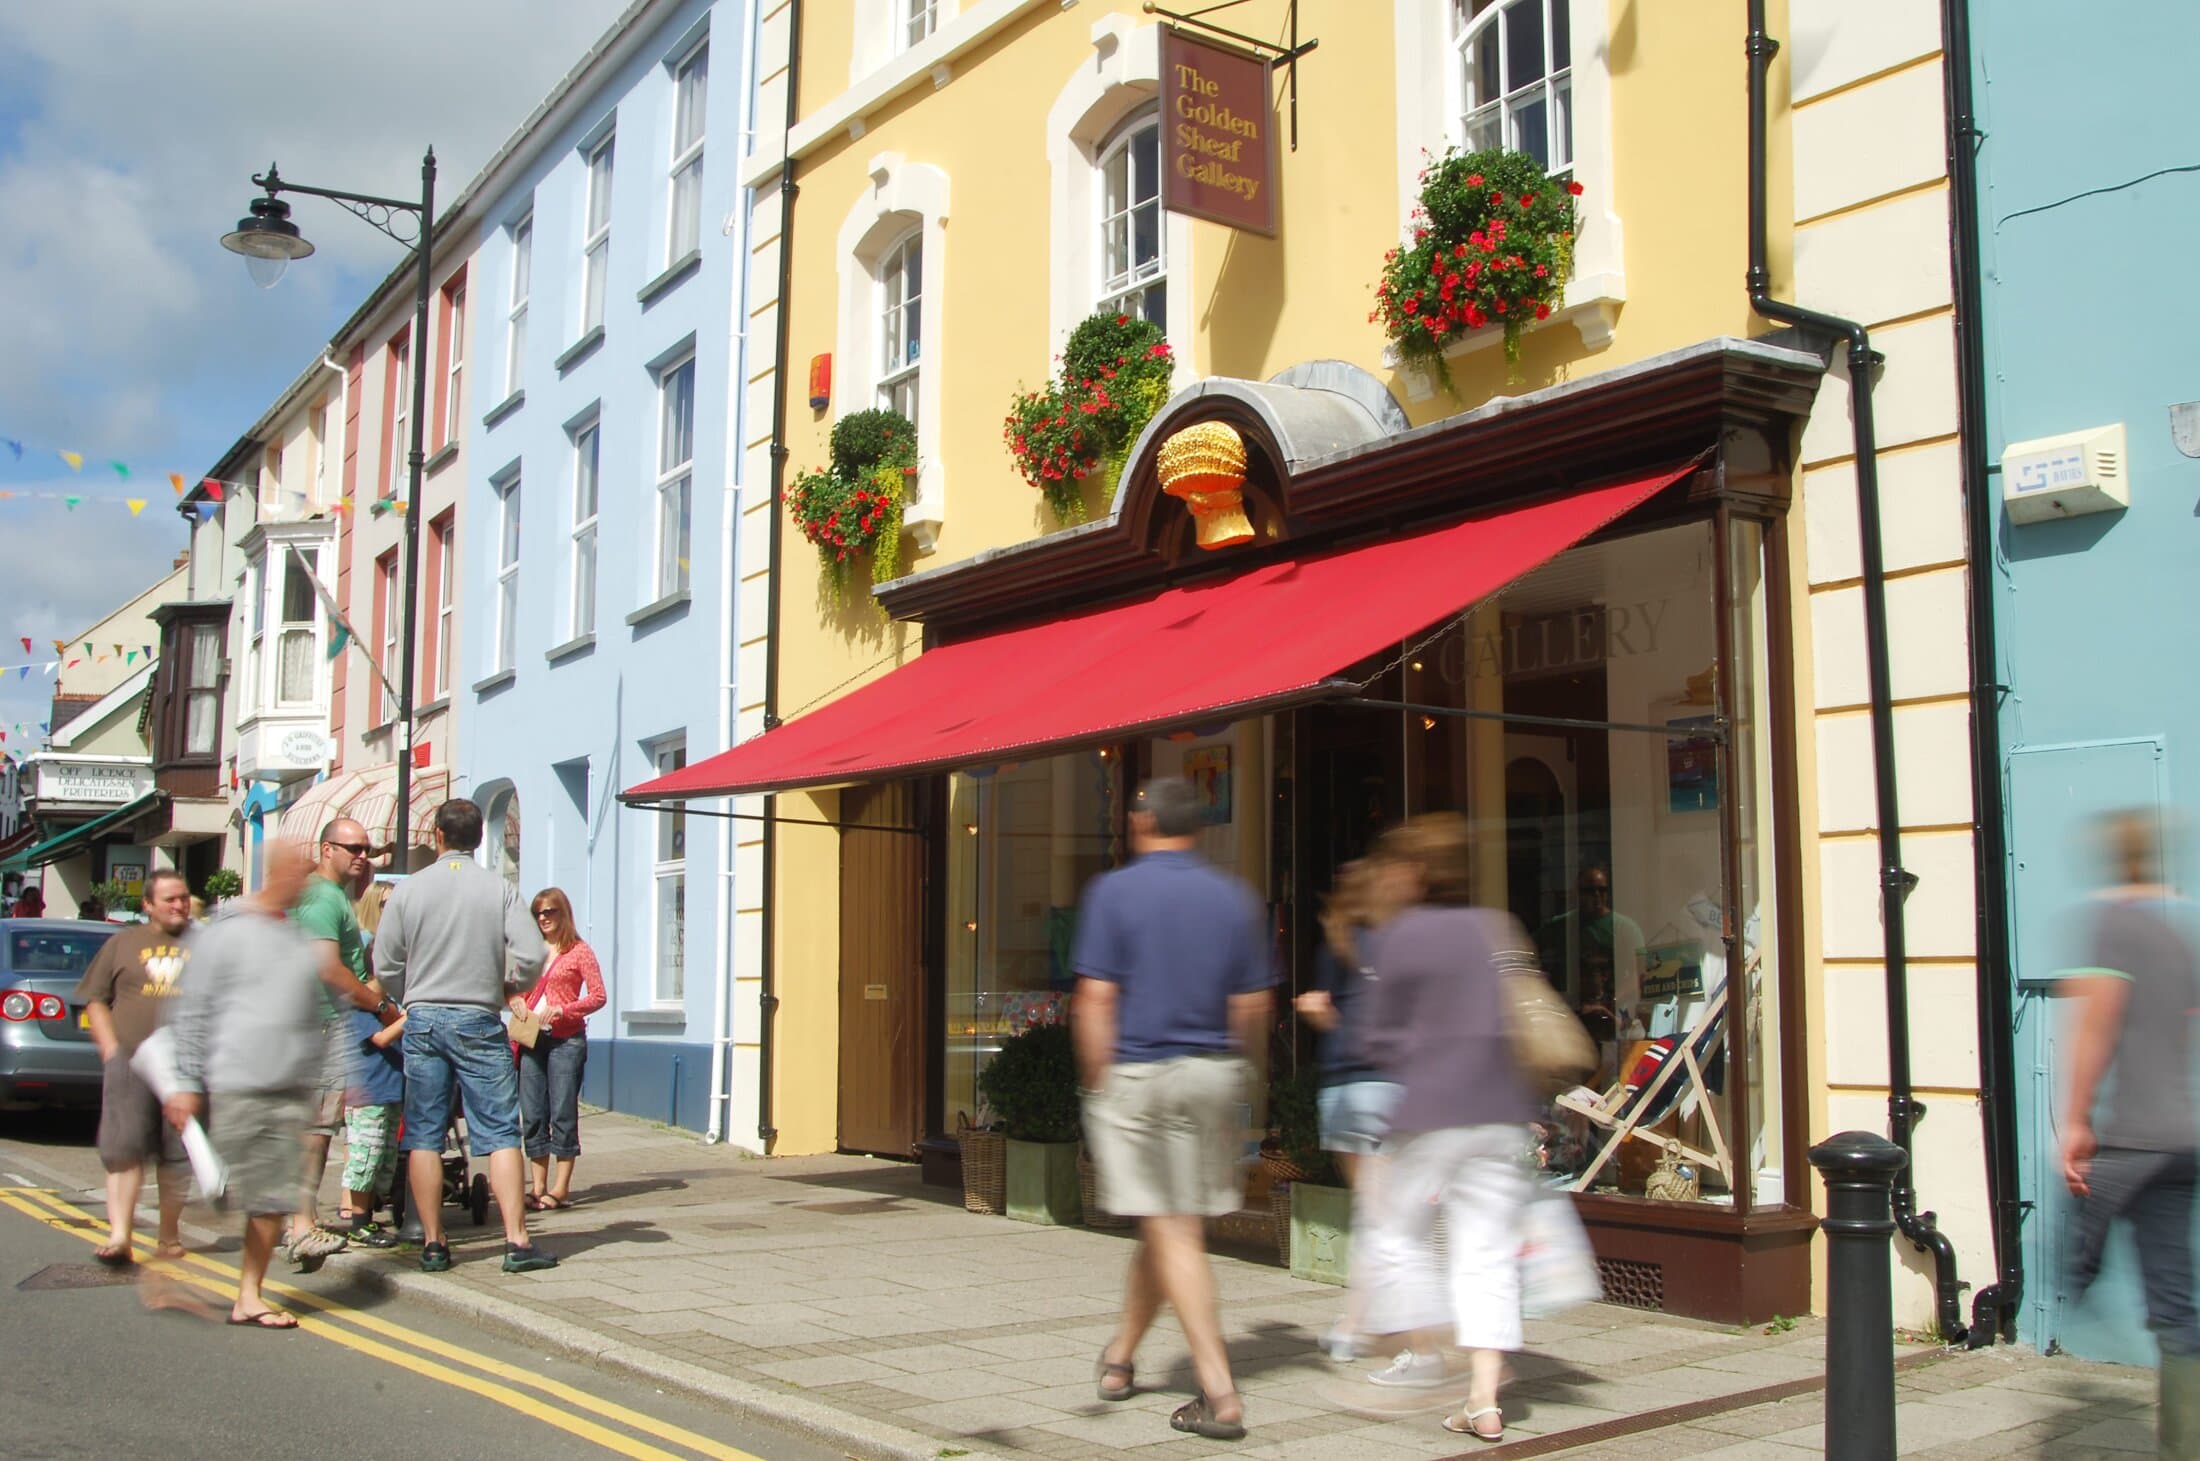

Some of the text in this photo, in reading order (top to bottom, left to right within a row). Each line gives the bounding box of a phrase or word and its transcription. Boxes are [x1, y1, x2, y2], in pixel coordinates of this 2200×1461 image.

[1175, 63, 1219, 97] The
[1175, 94, 1258, 139] Golden
[1175, 123, 1243, 162] Sheaf
[1176, 153, 1260, 200] Gallery
[1439, 599, 1671, 685] GALLERY
[58, 776, 136, 788] DELICATESSEN
[59, 766, 137, 778] OFF LICENCE
[63, 787, 129, 798] FRUITERERS
